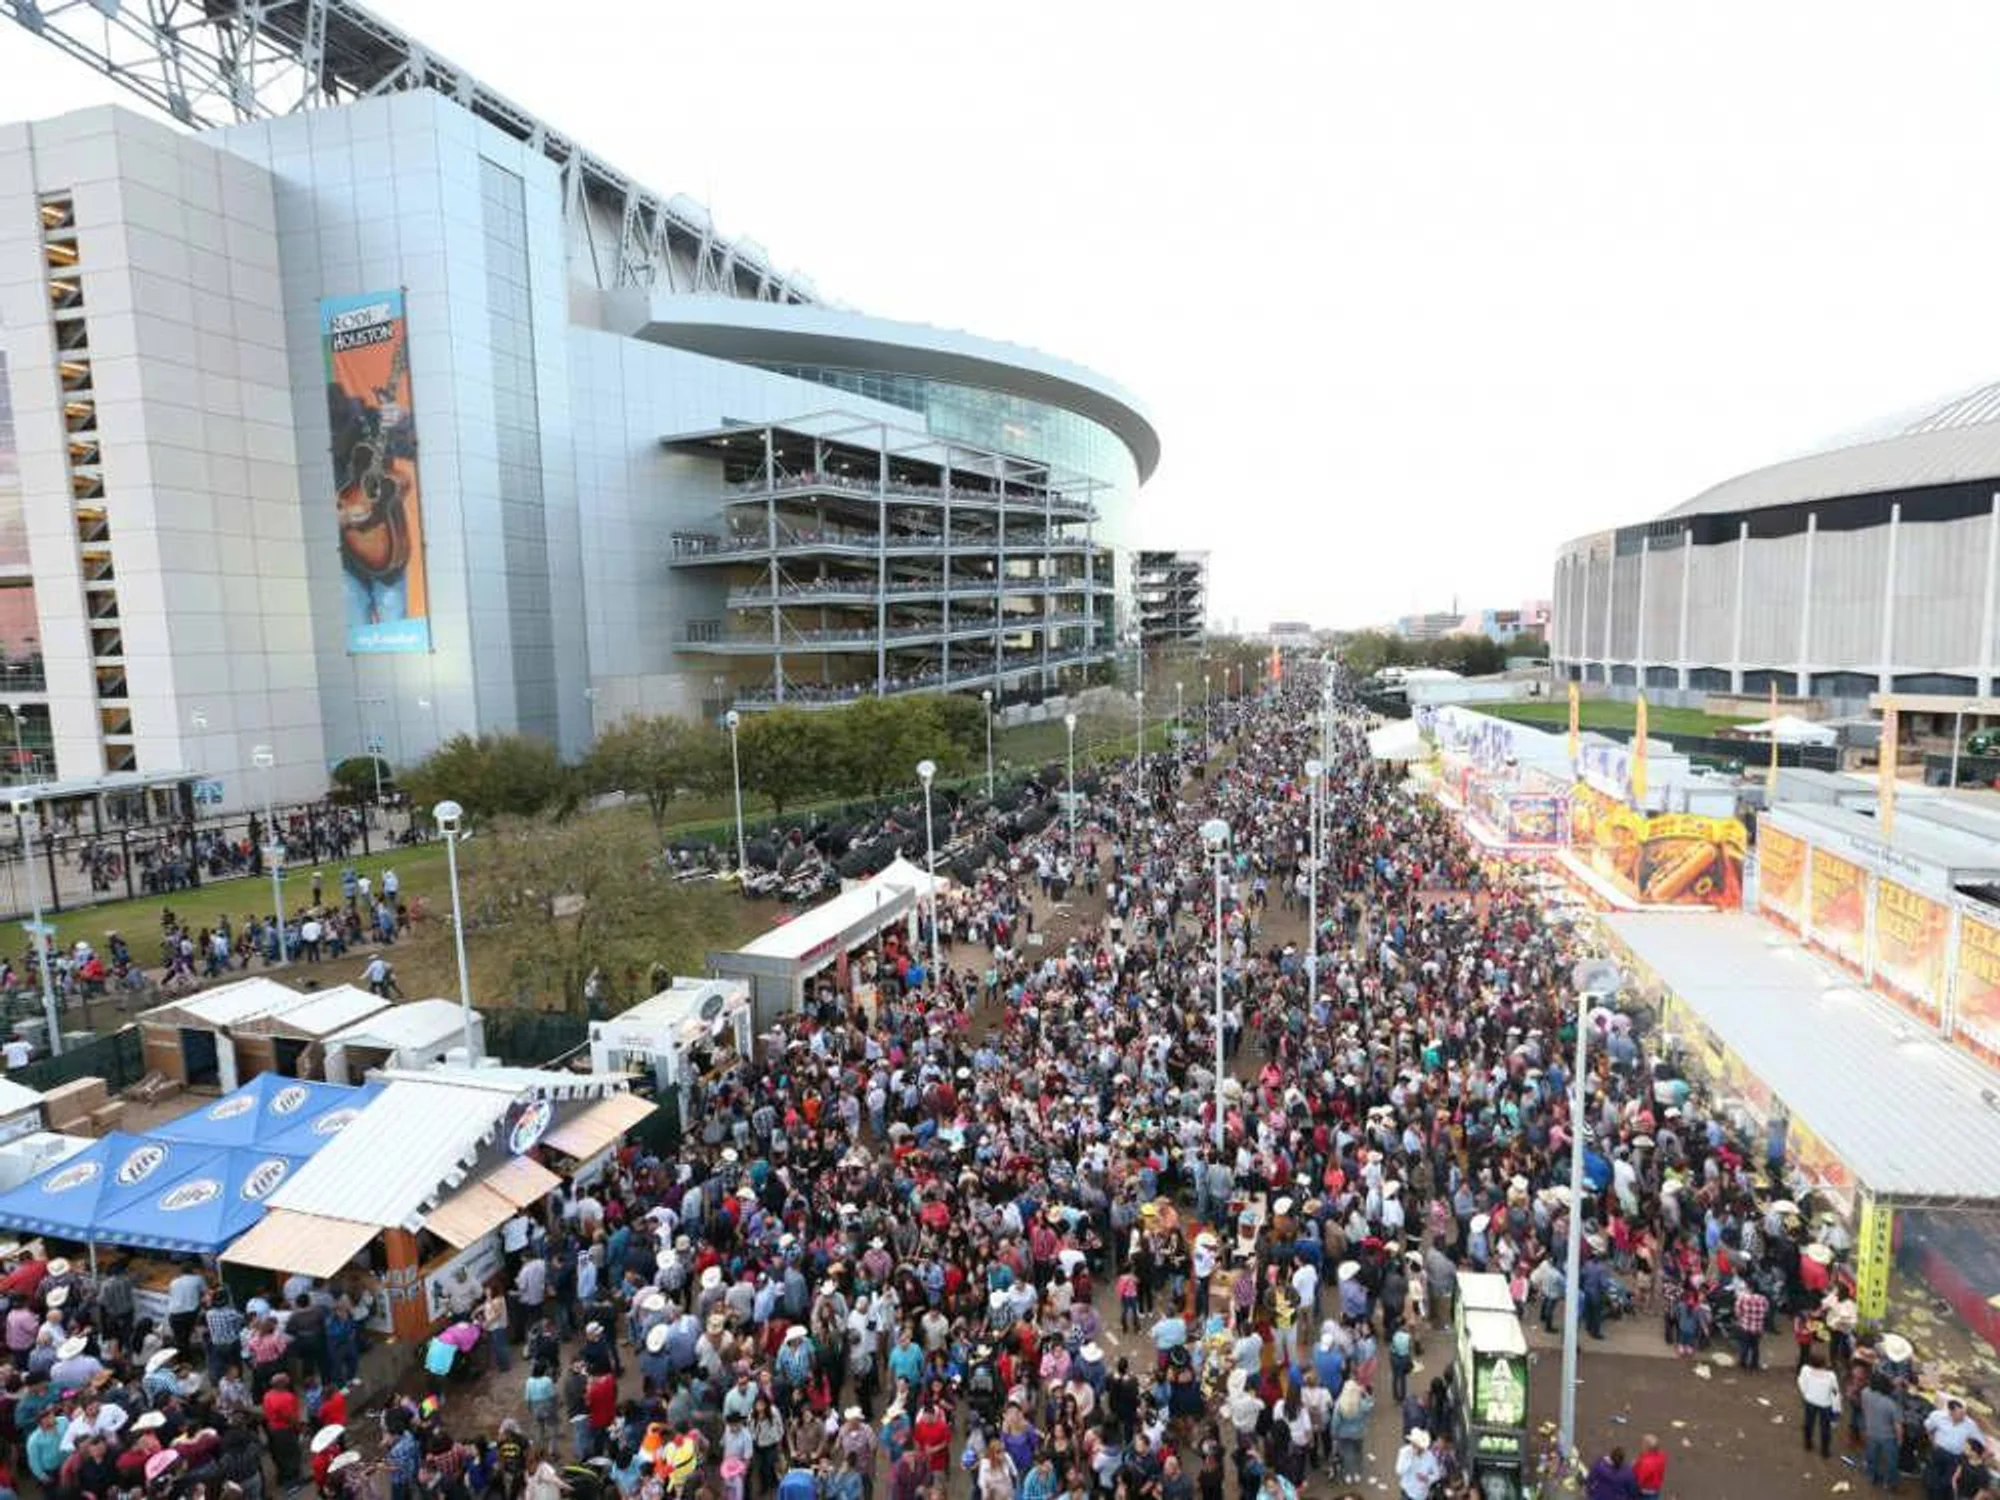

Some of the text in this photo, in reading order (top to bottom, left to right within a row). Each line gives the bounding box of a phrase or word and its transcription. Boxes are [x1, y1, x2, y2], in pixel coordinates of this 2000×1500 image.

[334, 322, 393, 351] HOUSTON
[128, 1151, 159, 1180] Lite
[252, 1163, 282, 1195] Lite
[1478, 1435, 1518, 1452] ATM
